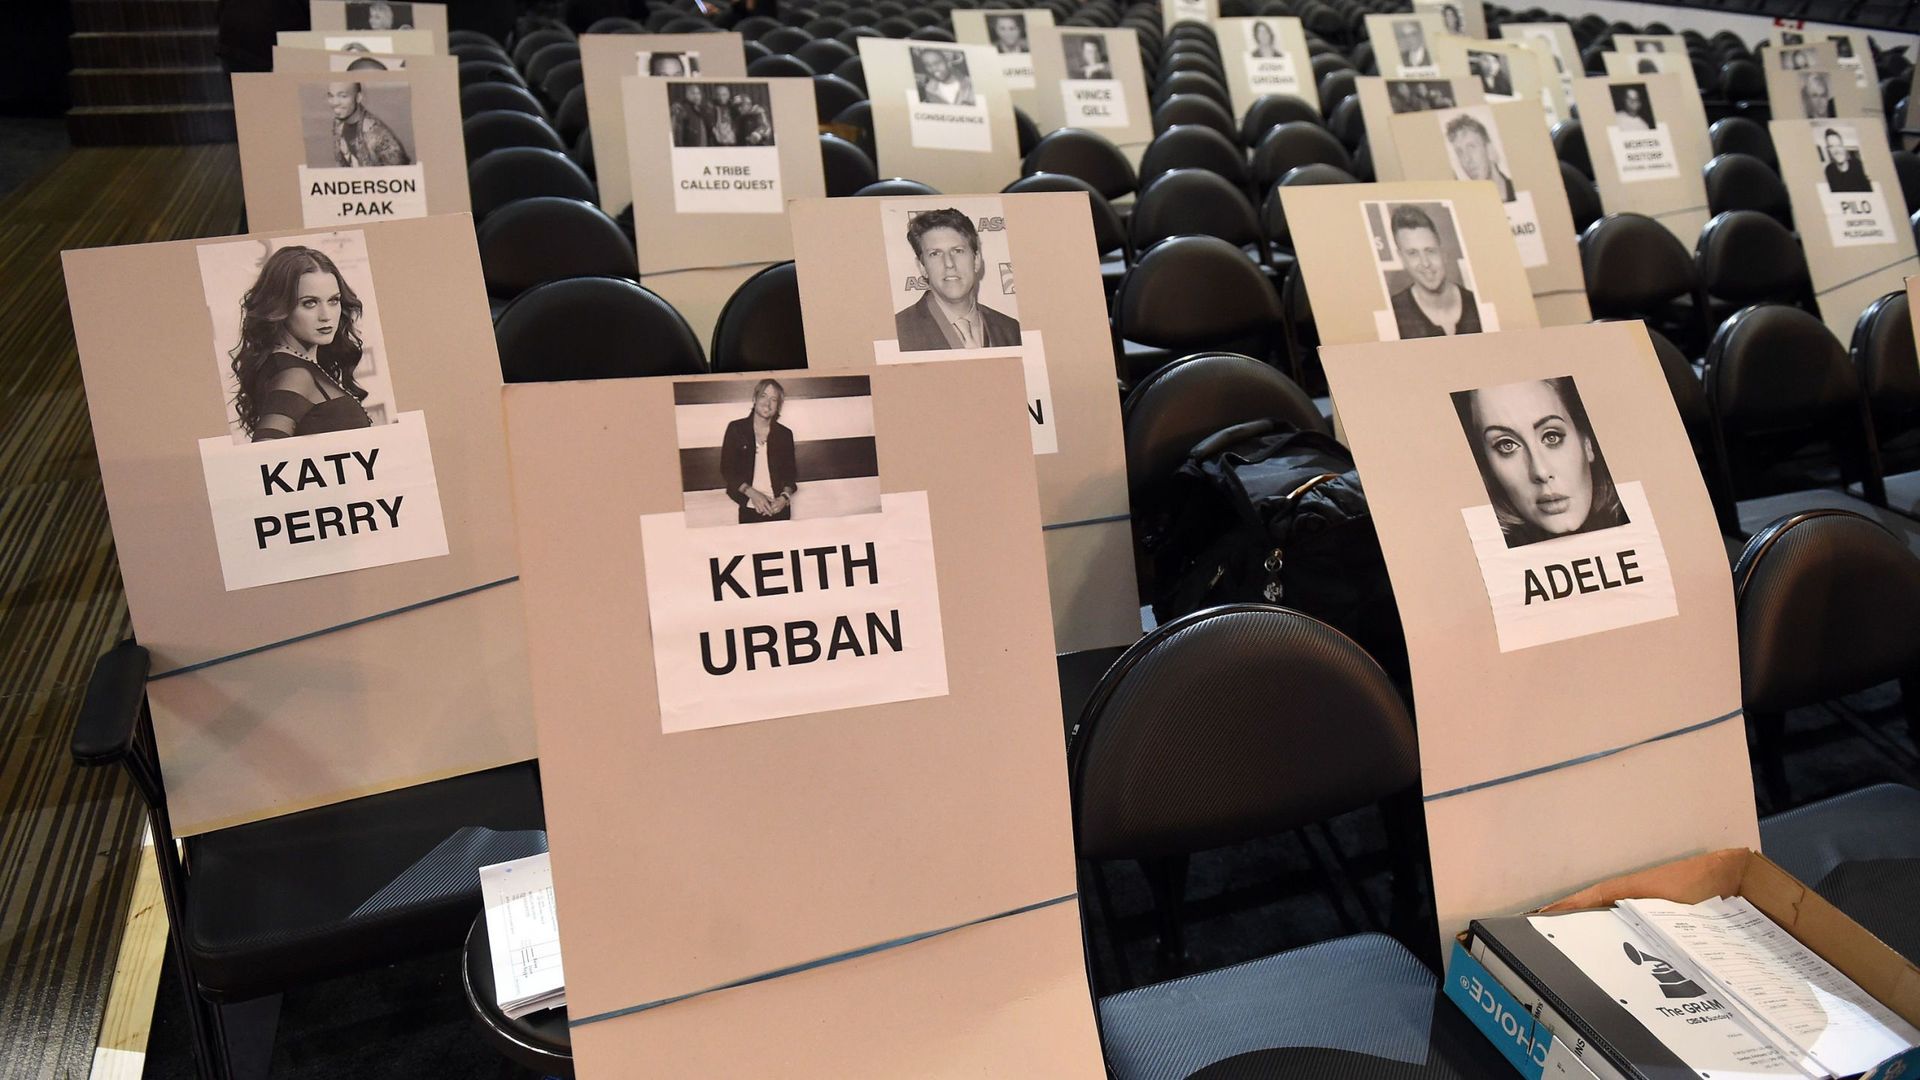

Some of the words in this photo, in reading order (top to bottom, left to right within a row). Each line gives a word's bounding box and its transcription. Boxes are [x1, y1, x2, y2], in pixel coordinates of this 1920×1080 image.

[1074, 89, 1112, 101] VINCE
[914, 112, 984, 124] CONSEQUENCE
[1081, 105, 1111, 116] GILL
[703, 166, 711, 176] A
[715, 165, 751, 176] TRIBE
[311, 179, 416, 196] ANDERSON
[680, 180, 730, 190] CALLED
[733, 179, 775, 190] QUEST
[337, 201, 394, 217] .PAAK
[1841, 200, 1872, 214] PILO
[260, 448, 380, 496] KATY
[254, 496, 403, 550] PERRY
[709, 542, 879, 602] KEITH
[1524, 549, 1644, 606] ADELE
[699, 609, 903, 676] URBAN
[1656, 1006, 1685, 1018] The
[1683, 999, 1725, 1015] GRAM
